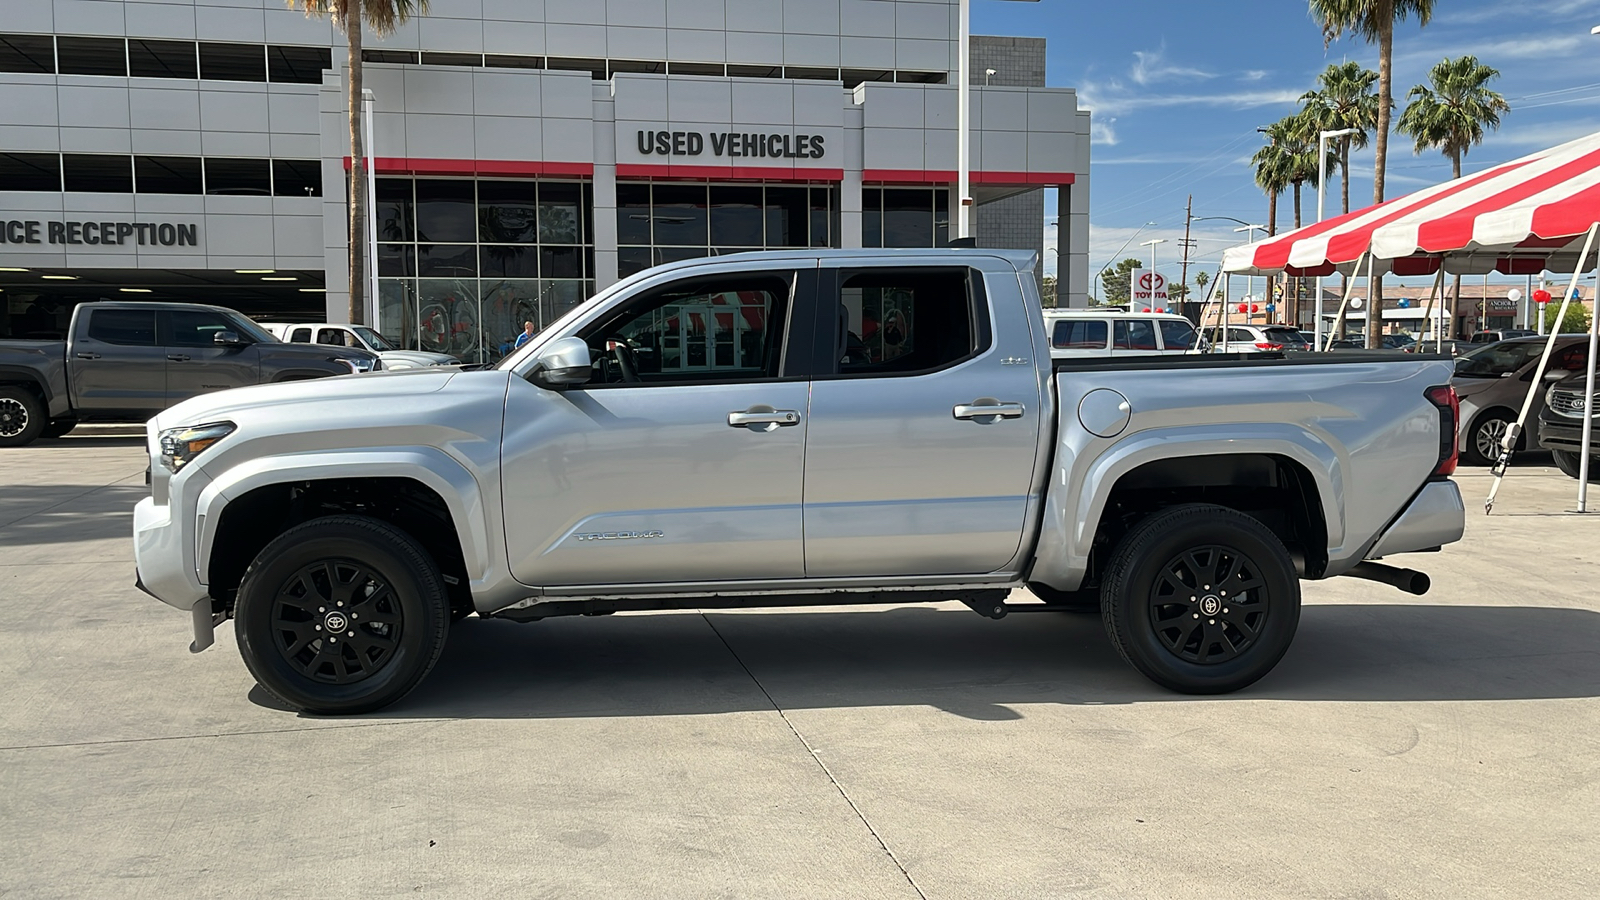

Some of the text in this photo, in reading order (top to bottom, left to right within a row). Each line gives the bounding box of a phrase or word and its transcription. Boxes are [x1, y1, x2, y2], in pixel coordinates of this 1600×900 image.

[638, 131, 825, 159] USED VEHICLES
[0, 220, 197, 246] ICE RECEPTION
[573, 530, 664, 541] TACOMA
